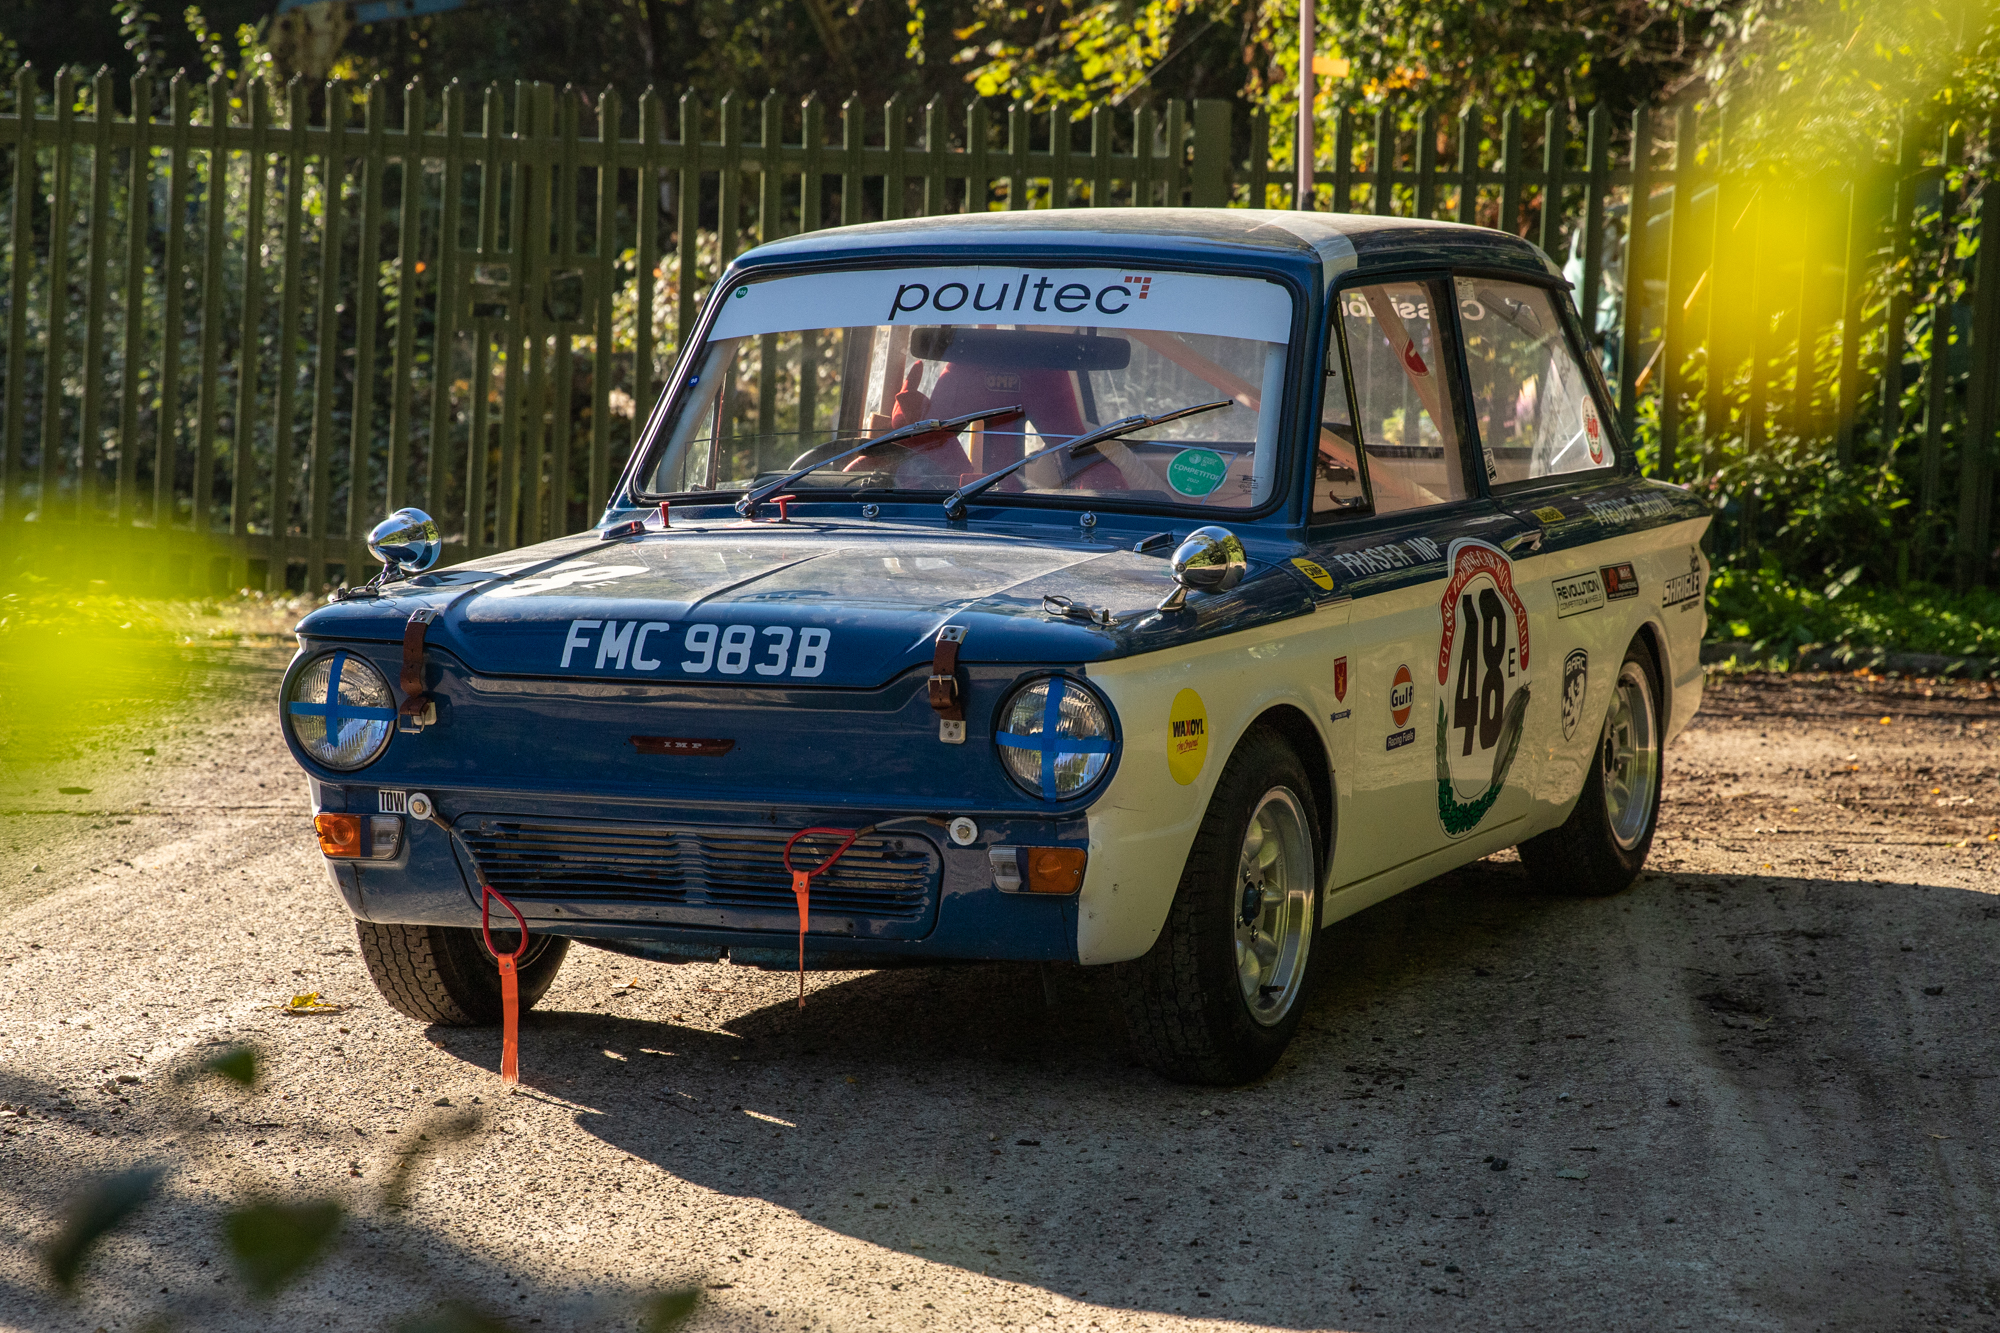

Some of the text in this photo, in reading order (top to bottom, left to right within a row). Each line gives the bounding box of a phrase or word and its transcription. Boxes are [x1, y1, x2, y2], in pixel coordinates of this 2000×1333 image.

[889, 274, 1131, 321] poultec
[1333, 536, 1442, 577] FRASER IMP
[1303, 564, 1325, 577] OMP
[1556, 579, 1600, 601] REVOLUTION
[1440, 550, 1528, 668] CLASSIC TOURING CAR RACING CLUB
[559, 619, 831, 678] FMC 983B
[1453, 587, 1507, 757] 48
[1507, 647, 1516, 678] E
[1566, 655, 1586, 677] BARC
[1391, 685, 1413, 708] Gulf
[1172, 718, 1205, 738] WAXOYL
[1387, 730, 1414, 748] Racing Fuels
[664, 741, 703, 749] IMP
[380, 791, 405, 812] TOW
